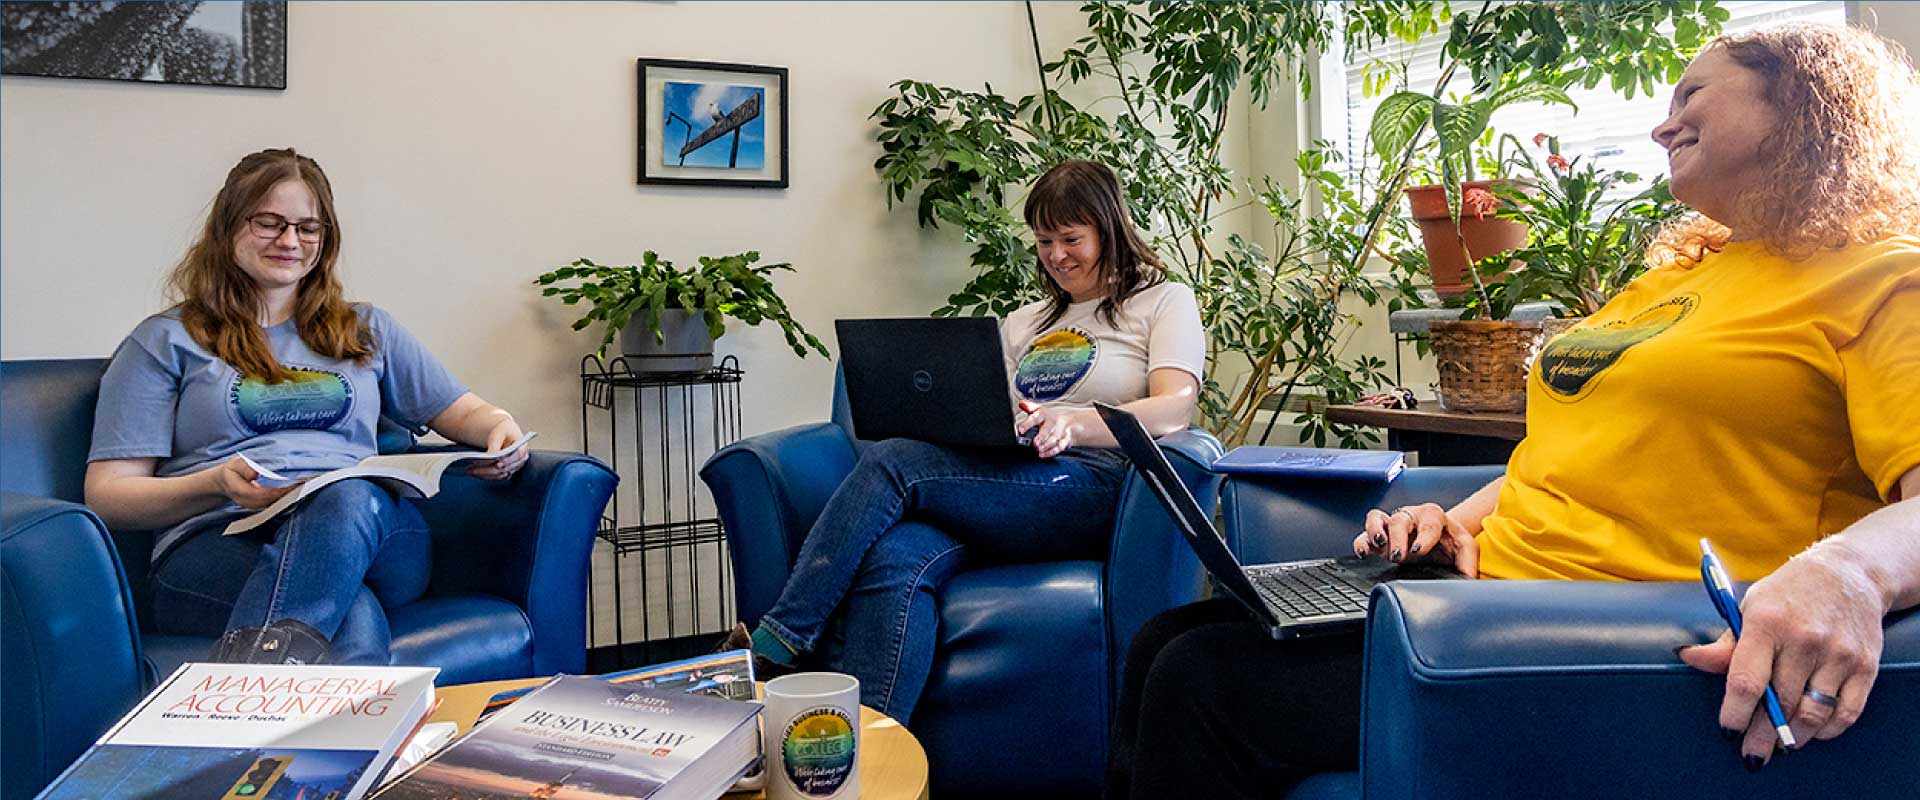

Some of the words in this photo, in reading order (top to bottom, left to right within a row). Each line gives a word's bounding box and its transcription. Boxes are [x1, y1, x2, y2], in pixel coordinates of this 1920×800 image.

[192, 674, 398, 697] MANAGERIAL
[168, 694, 394, 717] ACCOUNTING
[522, 709, 632, 739] BUSINESS
[630, 727, 695, 748] LAW
